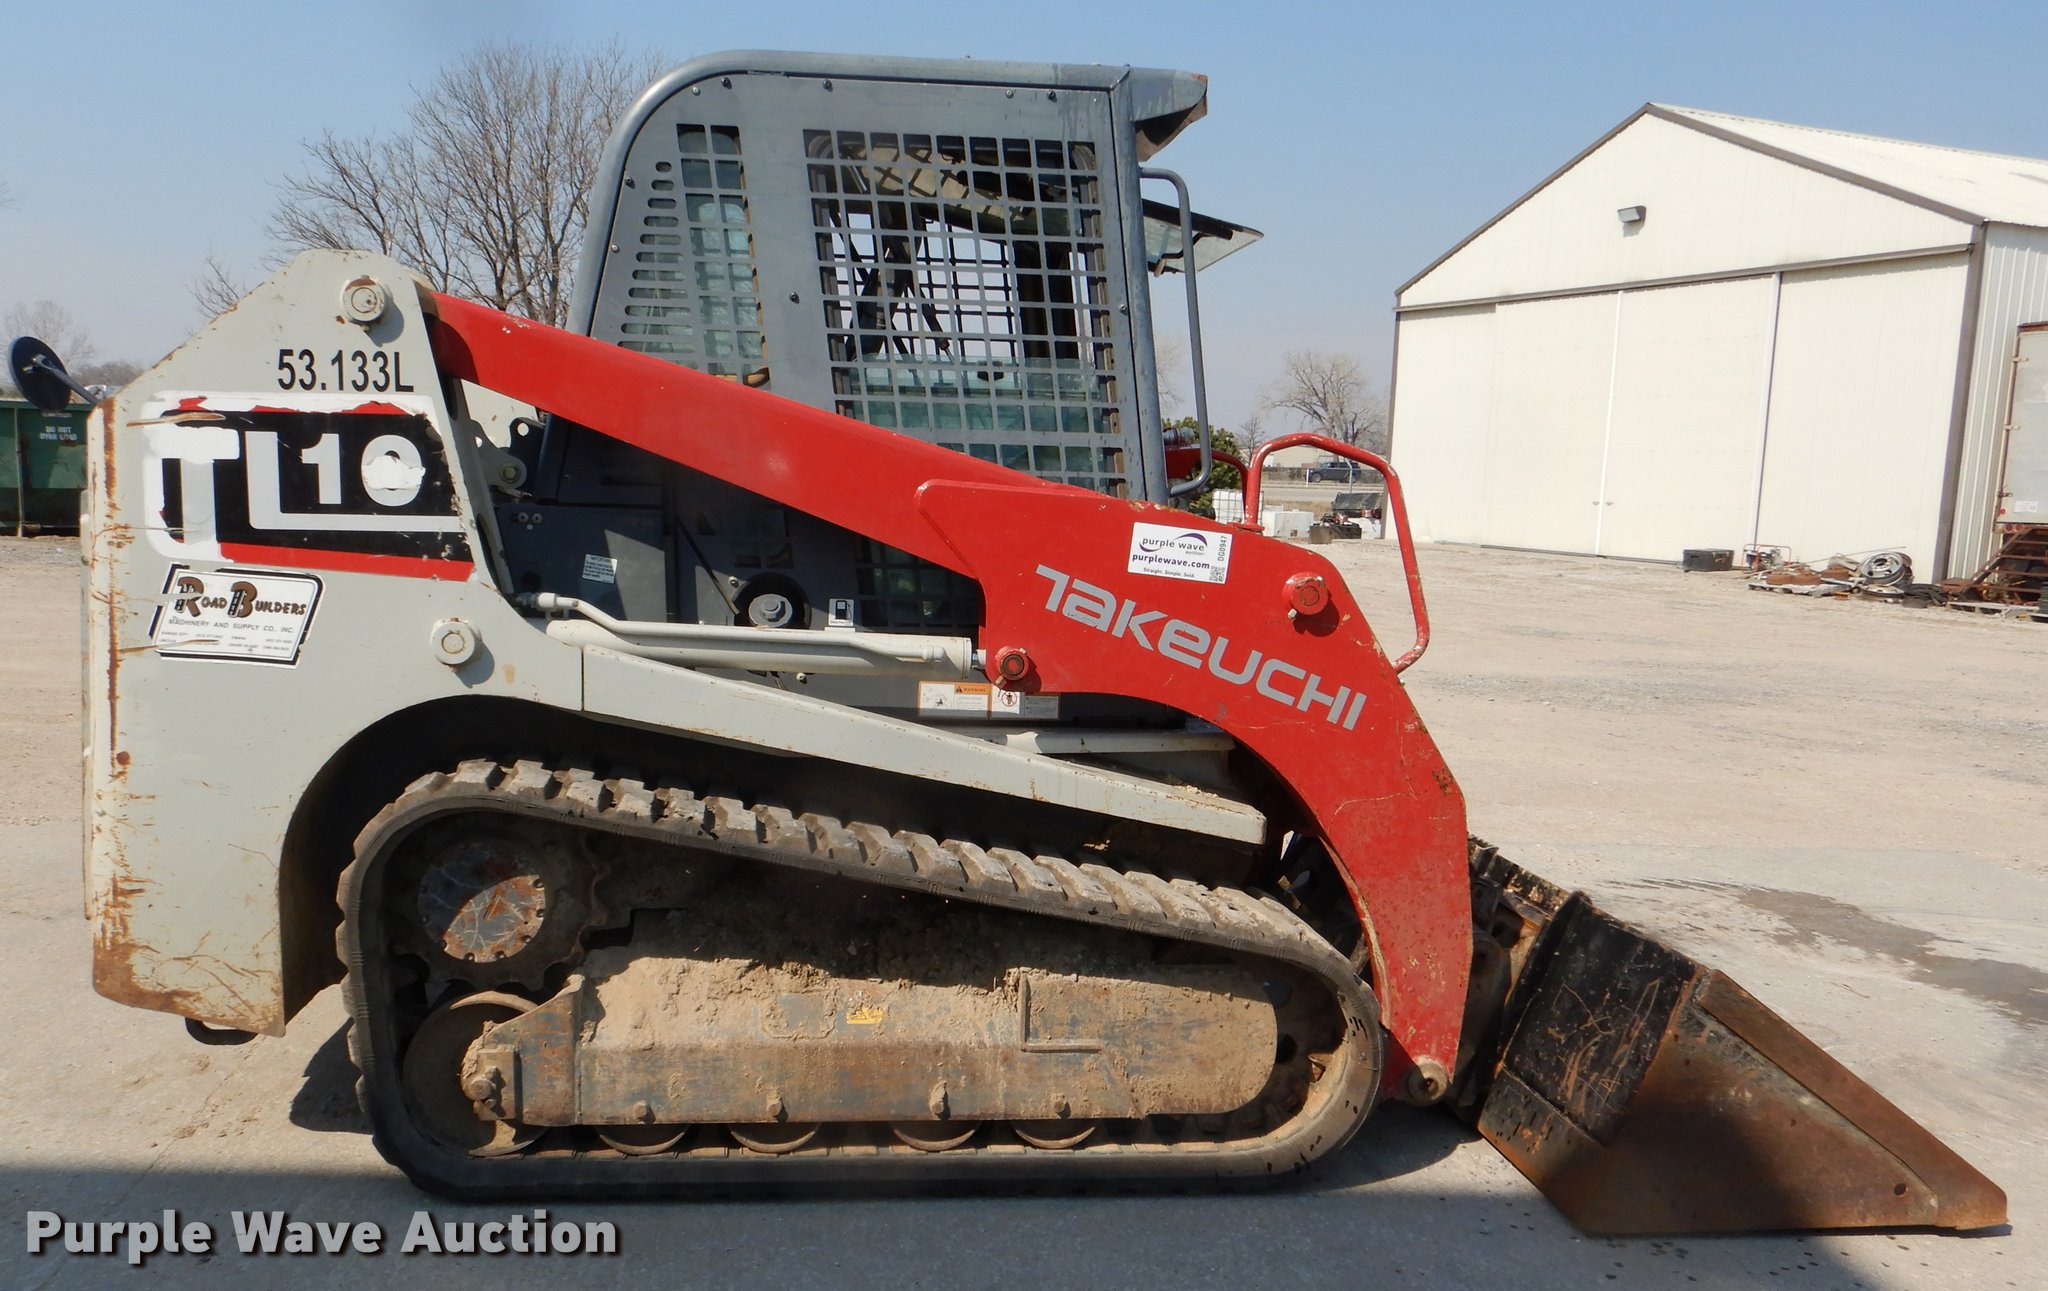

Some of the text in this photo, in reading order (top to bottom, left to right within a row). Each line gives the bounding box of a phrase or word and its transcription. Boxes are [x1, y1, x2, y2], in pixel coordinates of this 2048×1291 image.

[277, 348, 414, 393] 53.133L
[1142, 538, 1205, 551] purple wave
[1132, 553, 1210, 570] purplewave.com
[168, 618, 210, 628] MACHINERY
[213, 621, 230, 629] AND
[233, 623, 260, 631] SUPPLY
